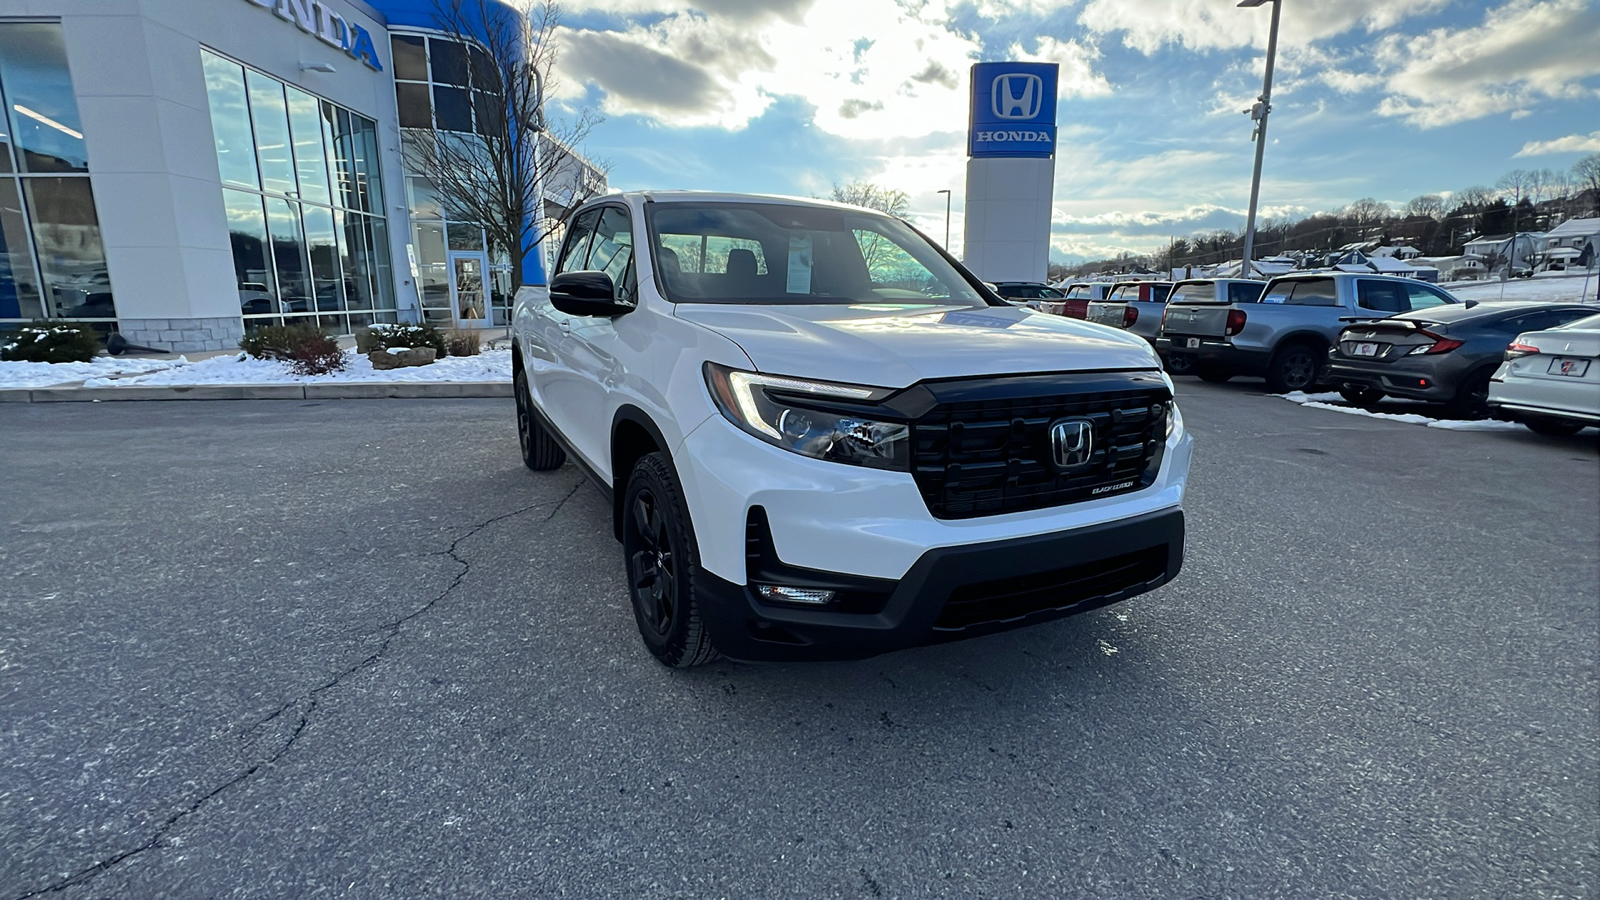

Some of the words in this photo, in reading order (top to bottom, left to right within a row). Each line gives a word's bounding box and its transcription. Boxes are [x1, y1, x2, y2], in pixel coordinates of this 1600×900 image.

[247, 0, 384, 72] NDA
[976, 131, 1052, 142] HONDA
[1092, 485, 1113, 494] BLACK
